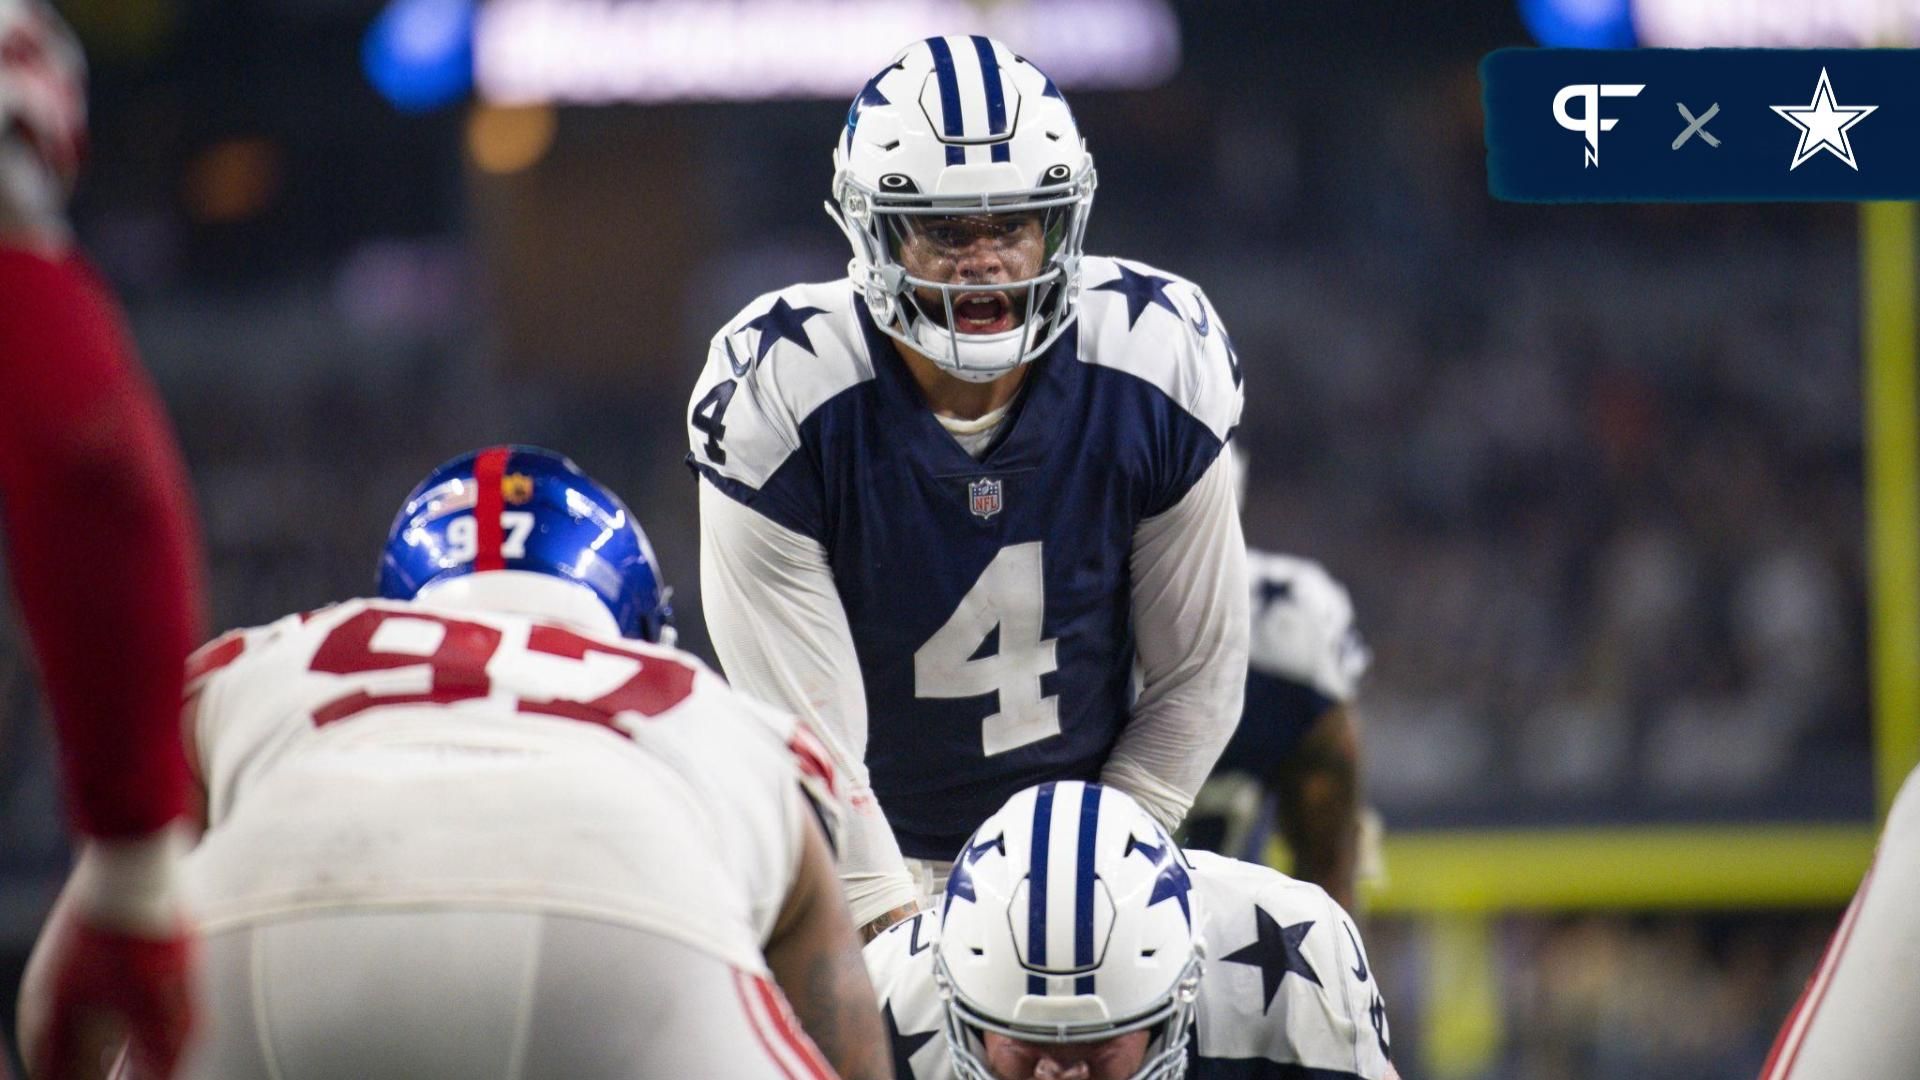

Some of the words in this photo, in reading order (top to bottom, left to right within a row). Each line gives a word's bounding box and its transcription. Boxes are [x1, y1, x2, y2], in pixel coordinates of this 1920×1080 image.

[691, 379, 738, 466] 4
[447, 514, 535, 564] 97
[975, 496, 998, 511] NFL
[308, 608, 696, 738] 97
[914, 541, 1061, 757] 4
